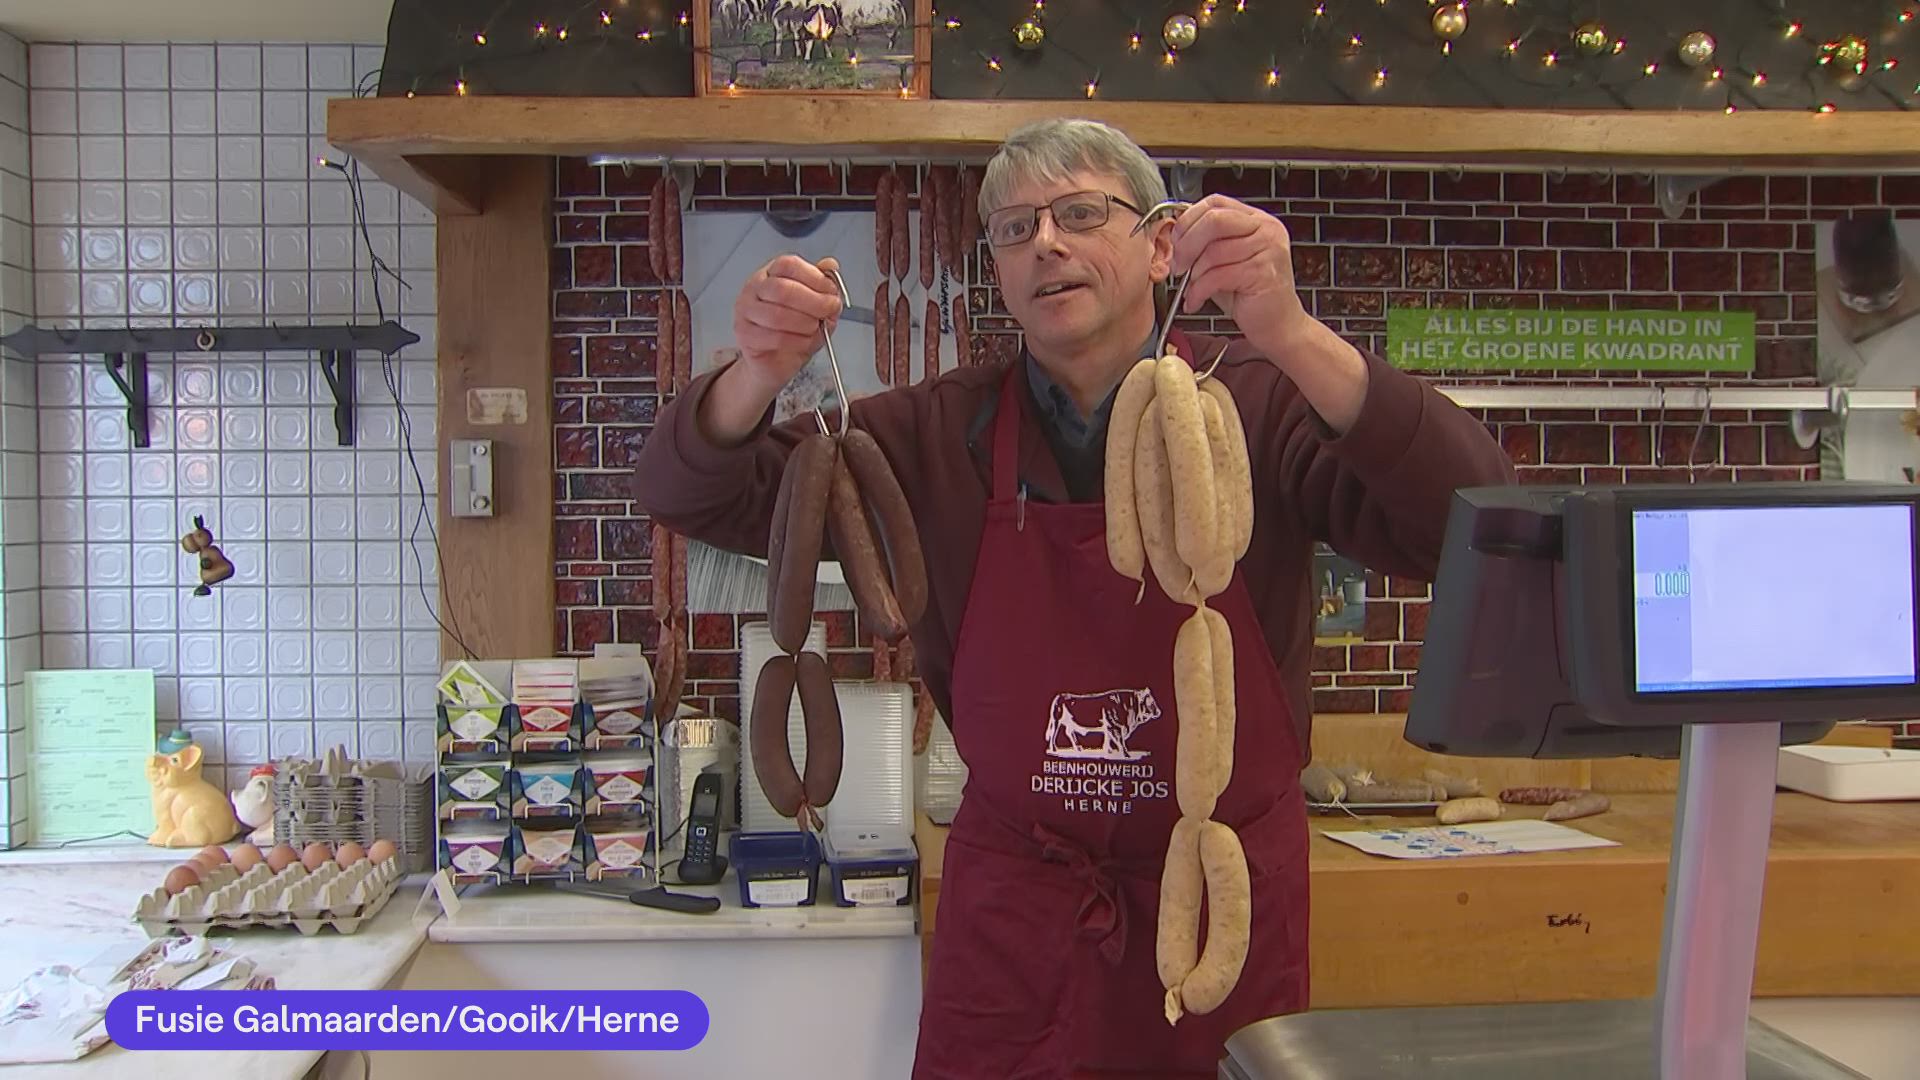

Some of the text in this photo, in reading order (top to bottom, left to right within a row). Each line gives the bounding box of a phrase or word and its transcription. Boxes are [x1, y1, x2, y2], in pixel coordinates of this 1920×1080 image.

[1424, 317, 1722, 337] ALLES BIJ DE HAND IN
[1401, 341, 1742, 361] HET GROENE KWADRANT
[1043, 761, 1153, 777] BEENHOUWERIJ
[1031, 776, 1169, 799] DERIJCKE JOS
[1064, 799, 1132, 814] HERNE
